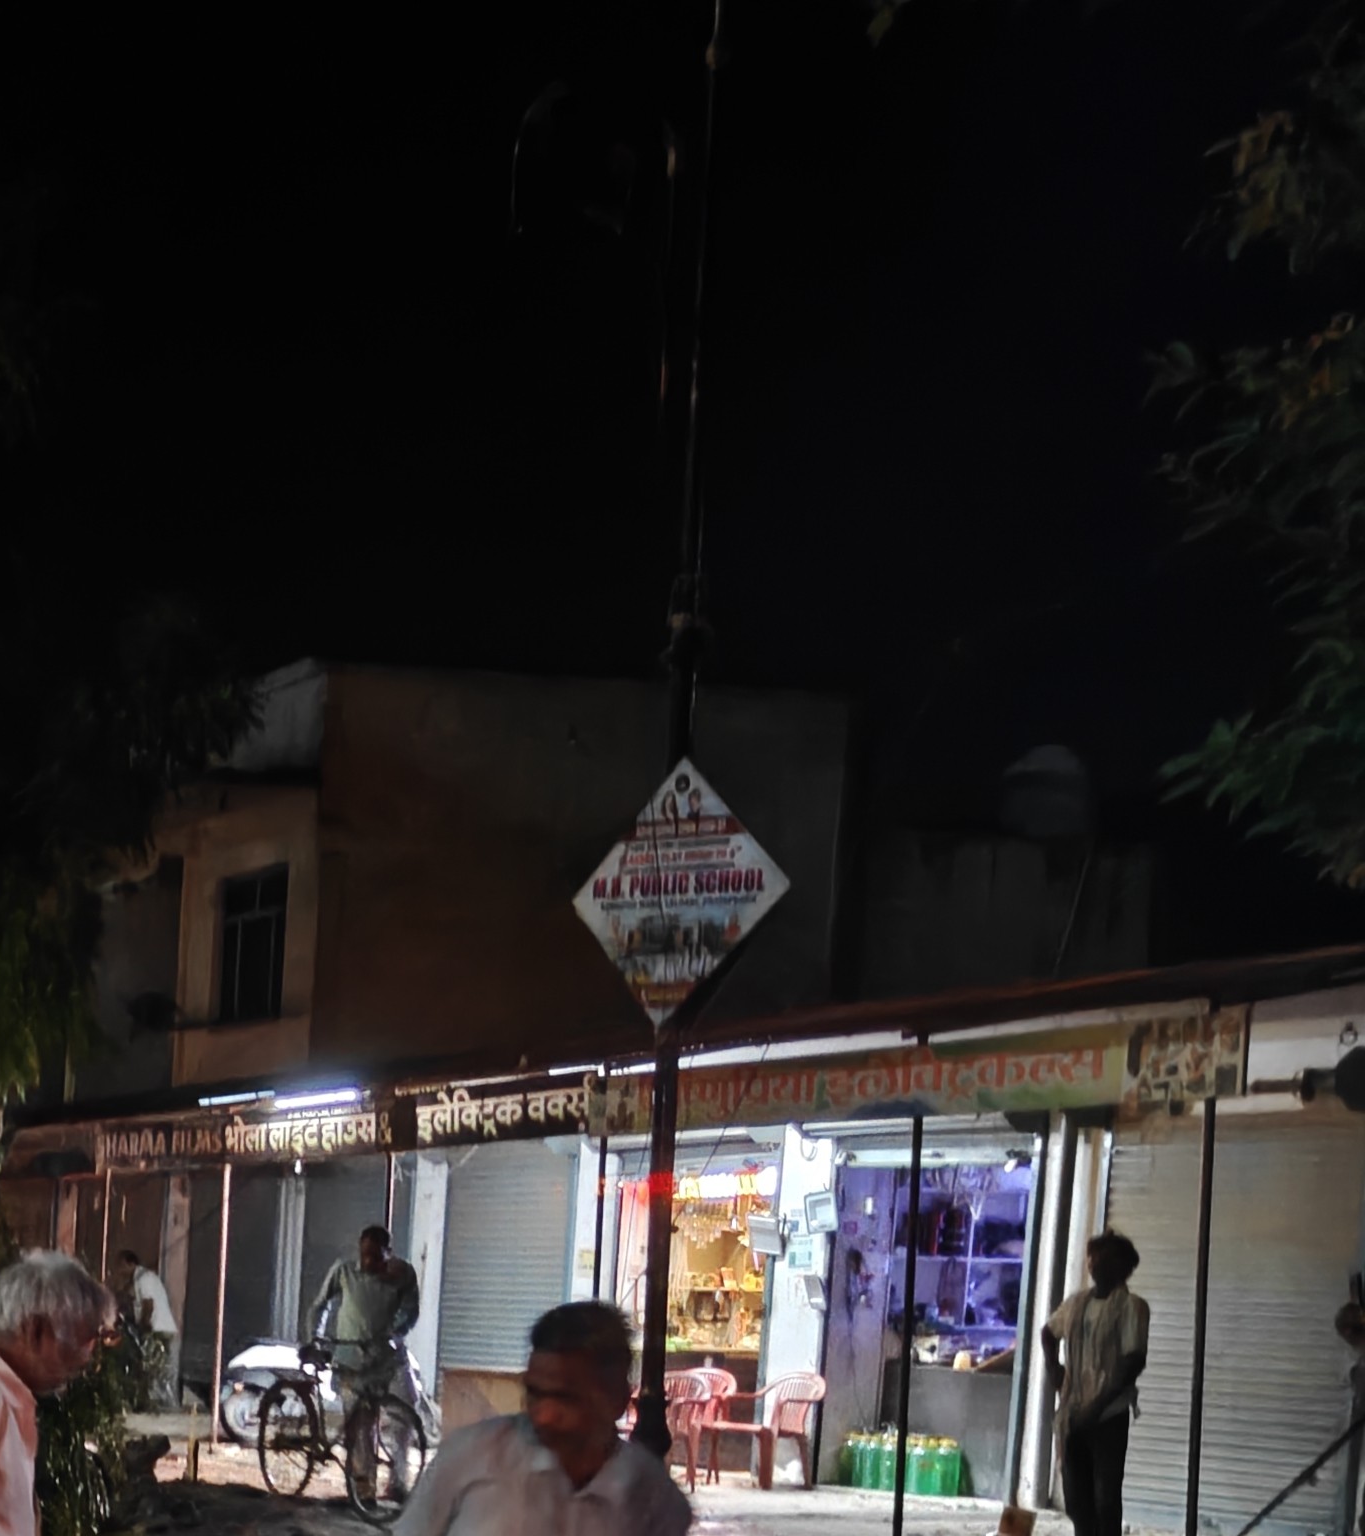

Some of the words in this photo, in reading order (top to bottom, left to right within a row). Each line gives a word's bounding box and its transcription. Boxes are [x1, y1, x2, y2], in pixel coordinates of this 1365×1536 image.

[629, 872, 690, 897] PUBLIC
[694, 867, 765, 894] SCHOOL
[171, 1129, 223, 1154] FILMS
[224, 1114, 267, 1153] भोला
[268, 1117, 319, 1158] लाइट
[319, 1112, 377, 1153] हाउस
